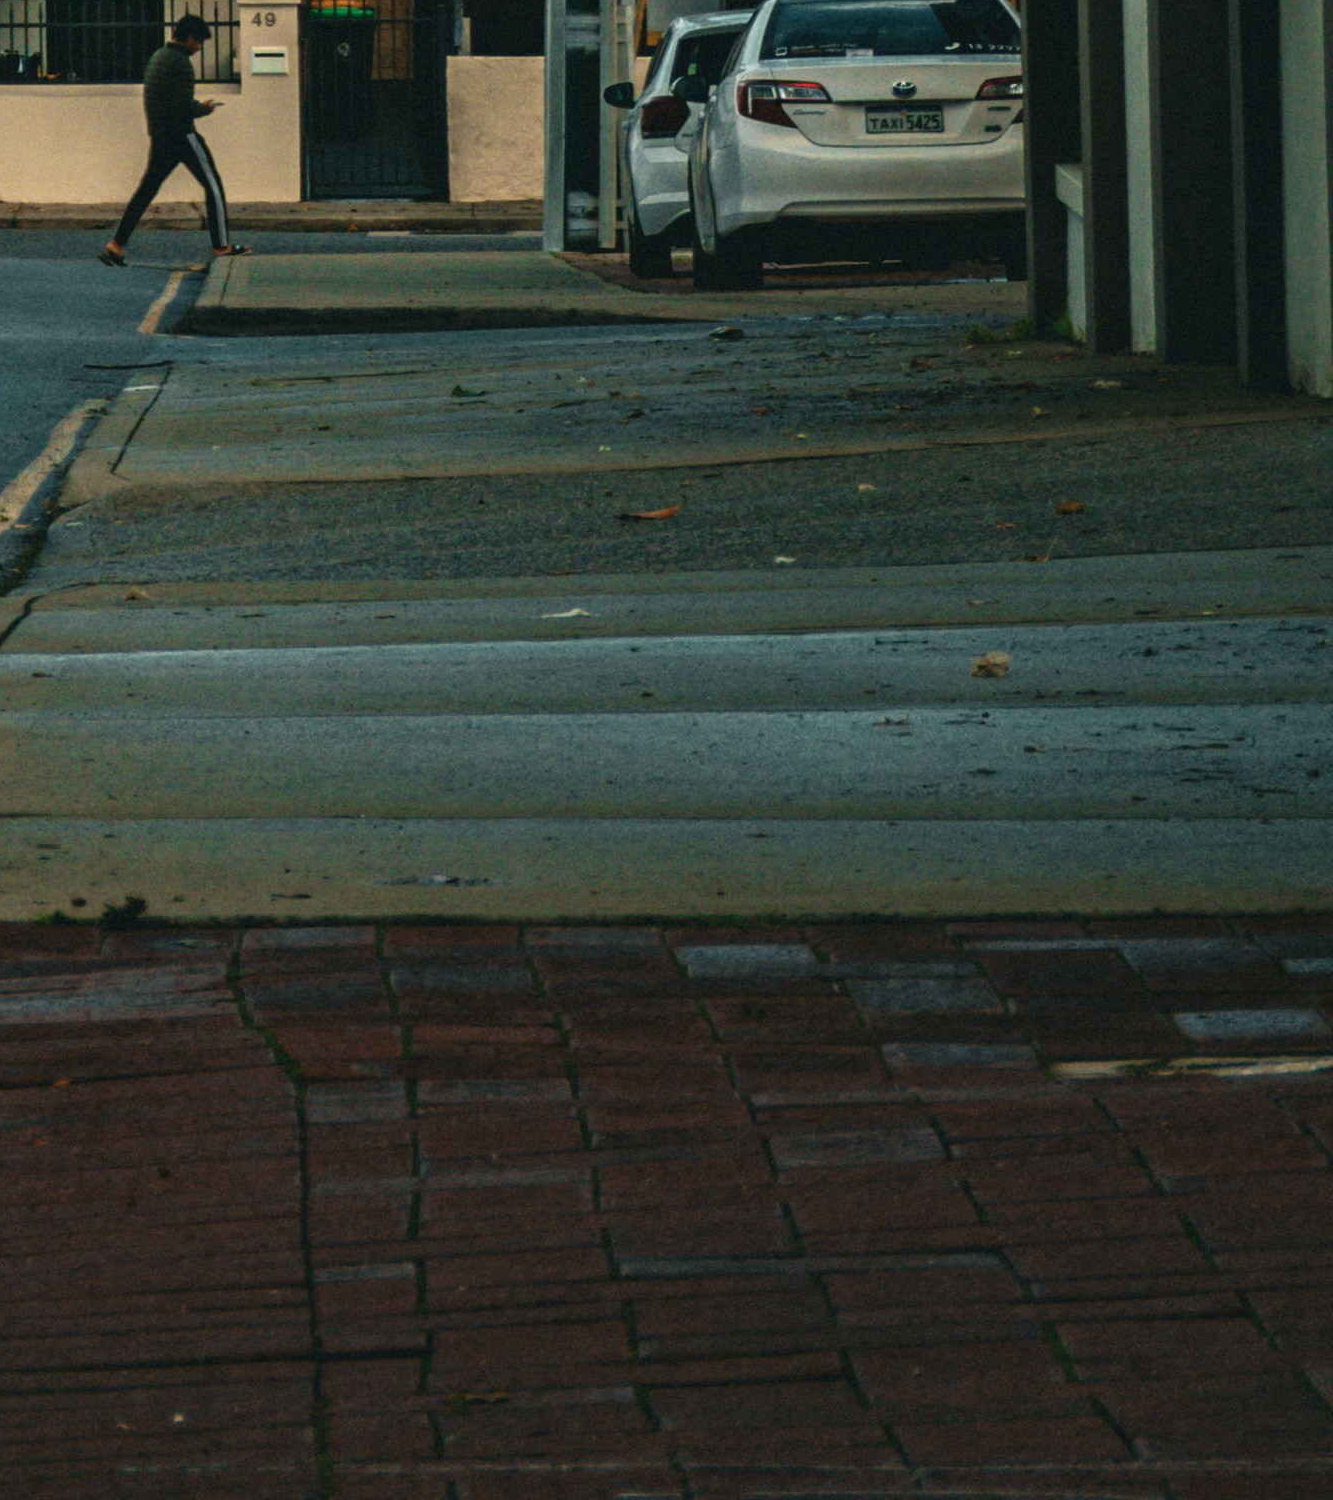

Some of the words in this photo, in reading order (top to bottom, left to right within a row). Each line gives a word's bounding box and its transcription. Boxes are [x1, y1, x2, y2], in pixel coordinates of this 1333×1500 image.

[251, 12, 276, 27] 49
[870, 118, 904, 130] TAXI
[906, 114, 940, 130] 5425
